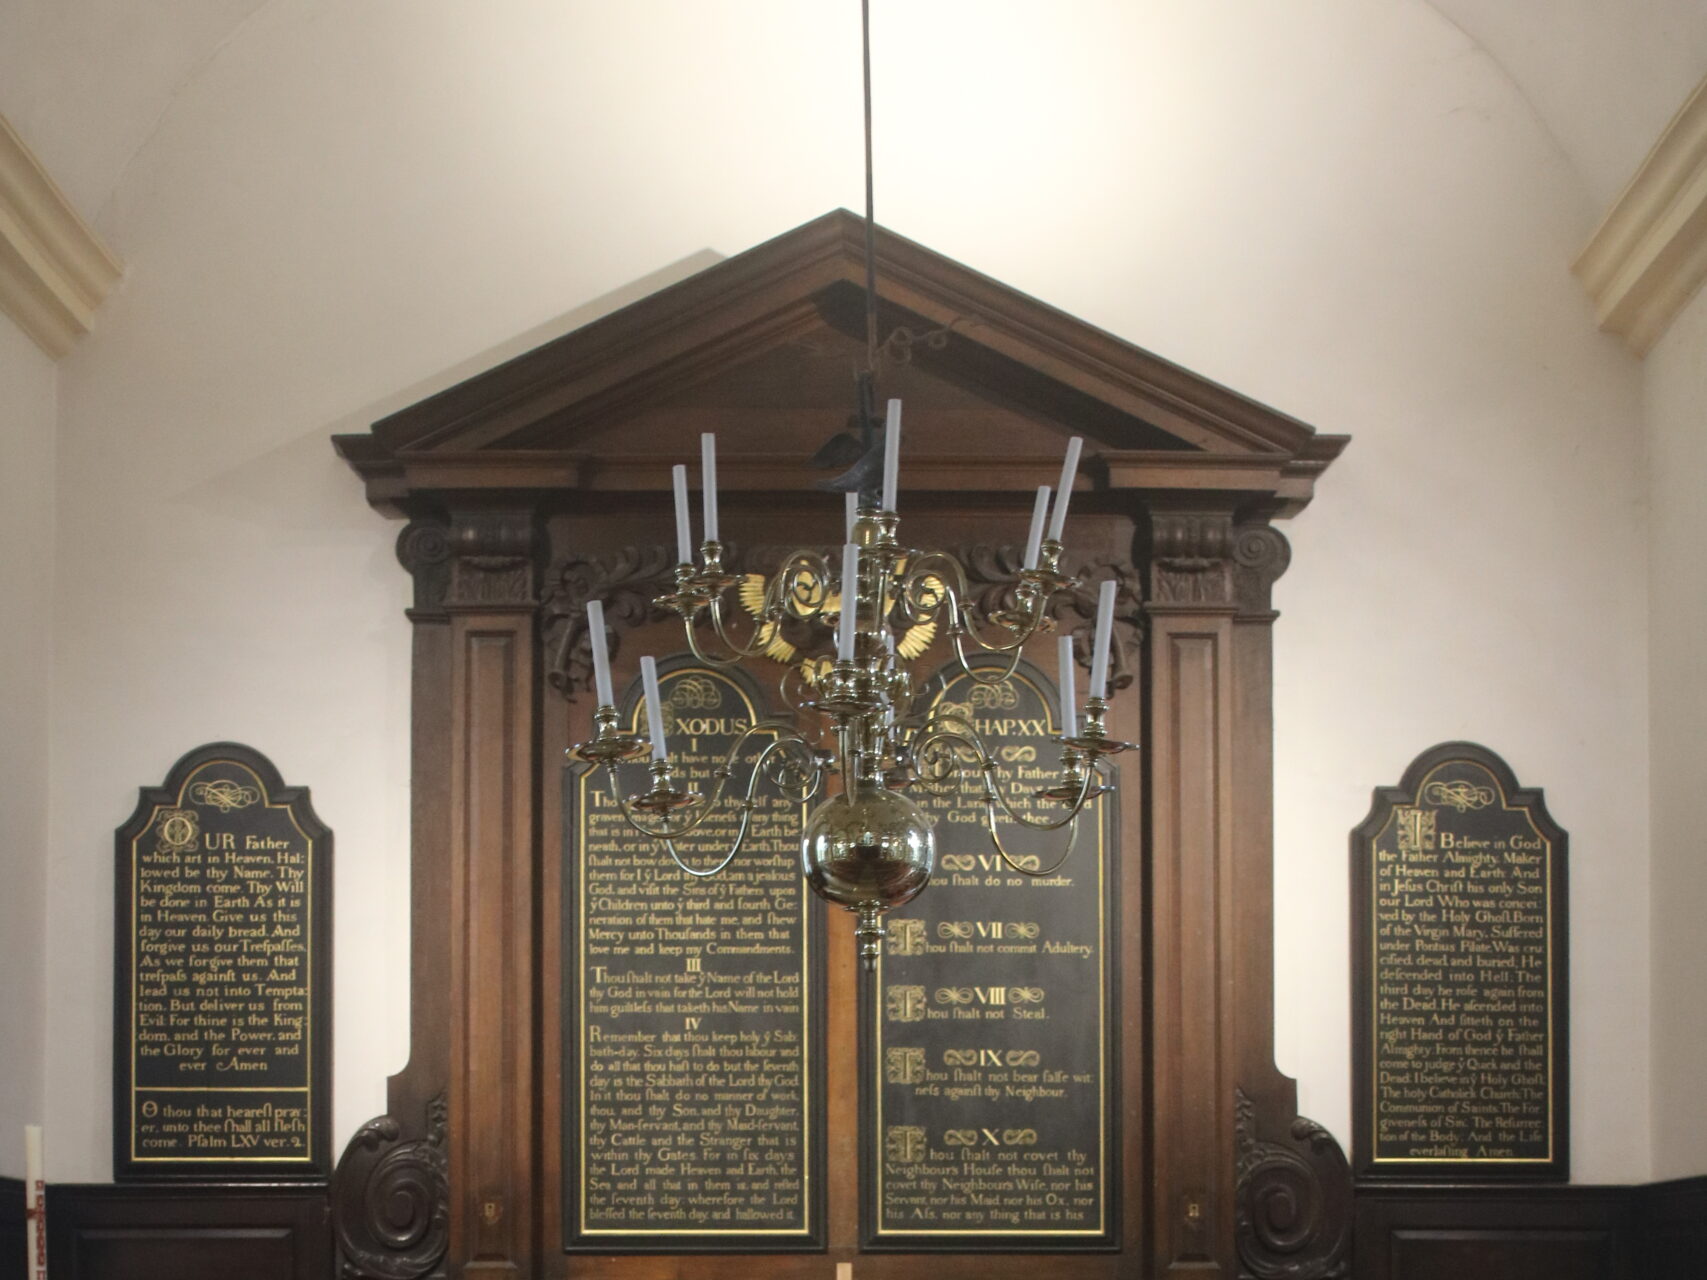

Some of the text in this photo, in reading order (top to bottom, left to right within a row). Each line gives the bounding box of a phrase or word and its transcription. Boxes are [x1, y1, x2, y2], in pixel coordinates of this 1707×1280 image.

[690, 738, 698, 752] I
[682, 754, 708, 764] have
[690, 768, 710, 778] but
[1018, 767, 1058, 779] Father
[688, 782, 699, 793] II
[933, 798, 1056, 809] the the
[948, 813, 976, 823] God
[246, 835, 289, 849] Father
[143, 853, 180, 864] which
[185, 855, 201, 864] art
[208, 853, 219, 864] in
[978, 855, 1002, 871] VI
[141, 867, 179, 878] lowed
[185, 867, 199, 878] be
[207, 868, 228, 882] thy
[278, 866, 303, 881] Thy
[985, 875, 1000, 886] do
[1007, 878, 1022, 886] no
[141, 880, 303, 896] Kingdom Thy Will
[141, 896, 300, 907] be done in Earth As it is
[141, 910, 296, 922] in Give us this
[139, 926, 161, 940] day
[193, 926, 223, 940] daily
[272, 926, 300, 936] And
[976, 922, 1002, 939] VII
[977, 943, 1037, 953] not commit
[140, 956, 299, 971] As we forgive them that
[140, 984, 251, 996] lead us not into
[974, 987, 1006, 1005] VIII
[170, 1001, 302, 1011] But deliver us from
[986, 1009, 1004, 1019] not
[140, 1044, 299, 1059] the Glory for ever and
[179, 1057, 267, 1071] ever Amen
[979, 1049, 1002, 1067] IX
[989, 1071, 1038, 1083] not bear
[984, 1086, 1000, 1101] thy
[232, 1136, 260, 1147] LXV
[982, 1129, 1000, 1145] X
[998, 1149, 1087, 1166] not covet thy
[1008, 1165, 1094, 1176] thou not
[886, 1180, 1093, 1193] covet thy nor his
[1074, 1196, 1093, 1206] nor
[943, 1210, 1083, 1224] nor any thing that is his
